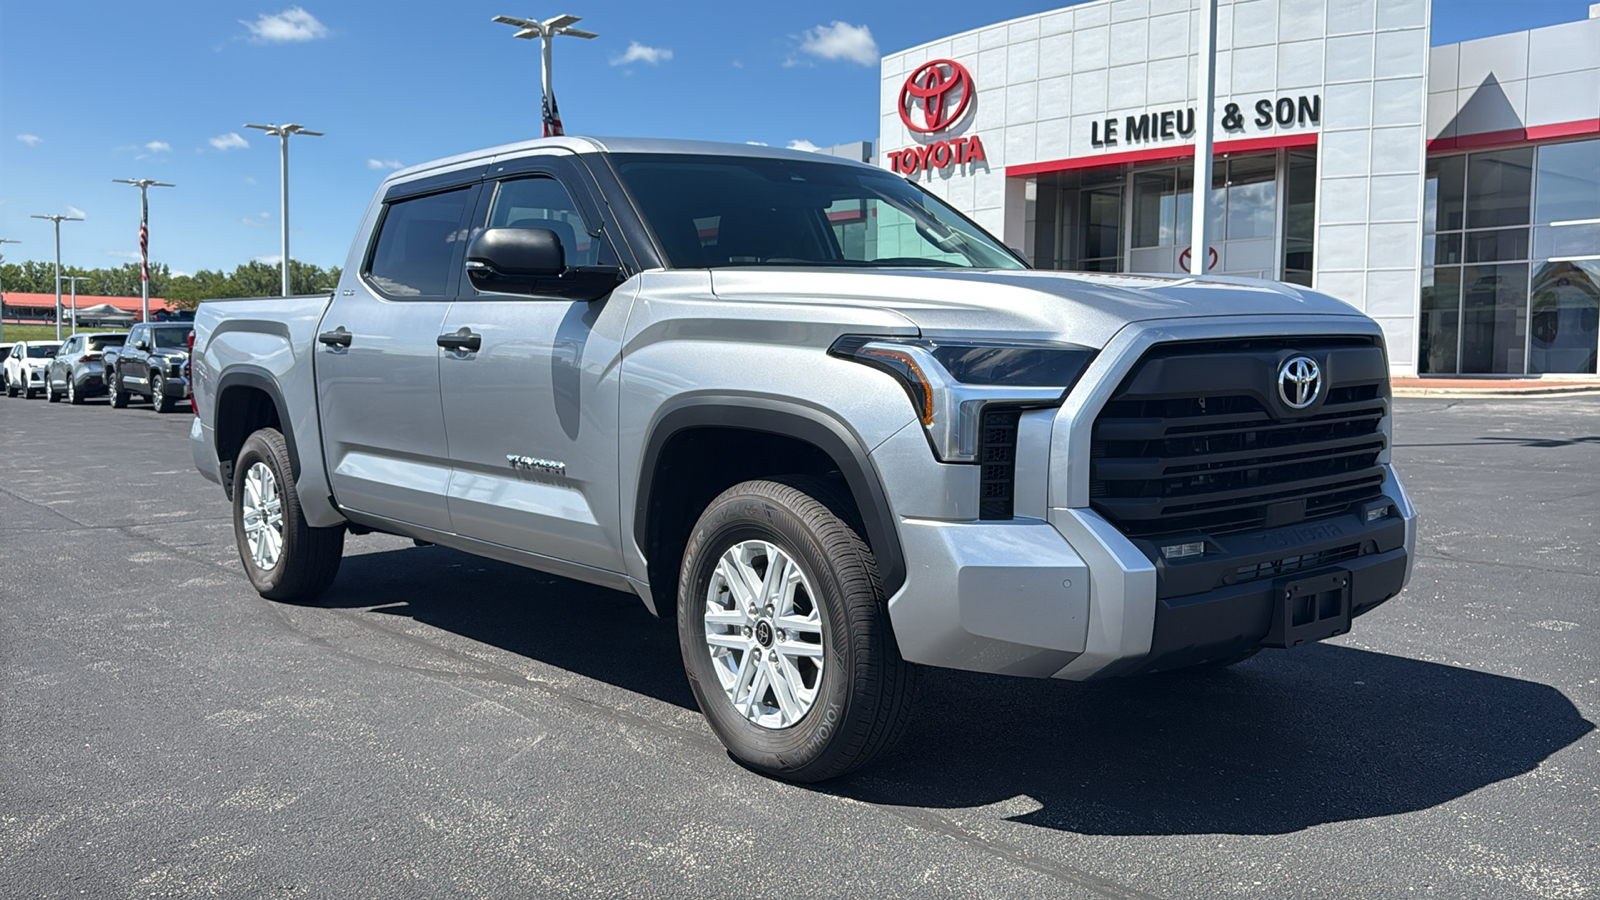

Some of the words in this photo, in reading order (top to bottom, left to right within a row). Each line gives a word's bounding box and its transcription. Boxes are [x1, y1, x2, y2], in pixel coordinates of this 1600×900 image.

[1091, 118, 1118, 146] LE
[1125, 107, 1215, 138] MIEU
[1221, 102, 1243, 131] &
[1254, 94, 1320, 128] SON
[887, 135, 985, 175] TOYOTA
[793, 702, 841, 764] YOKOHAMA
